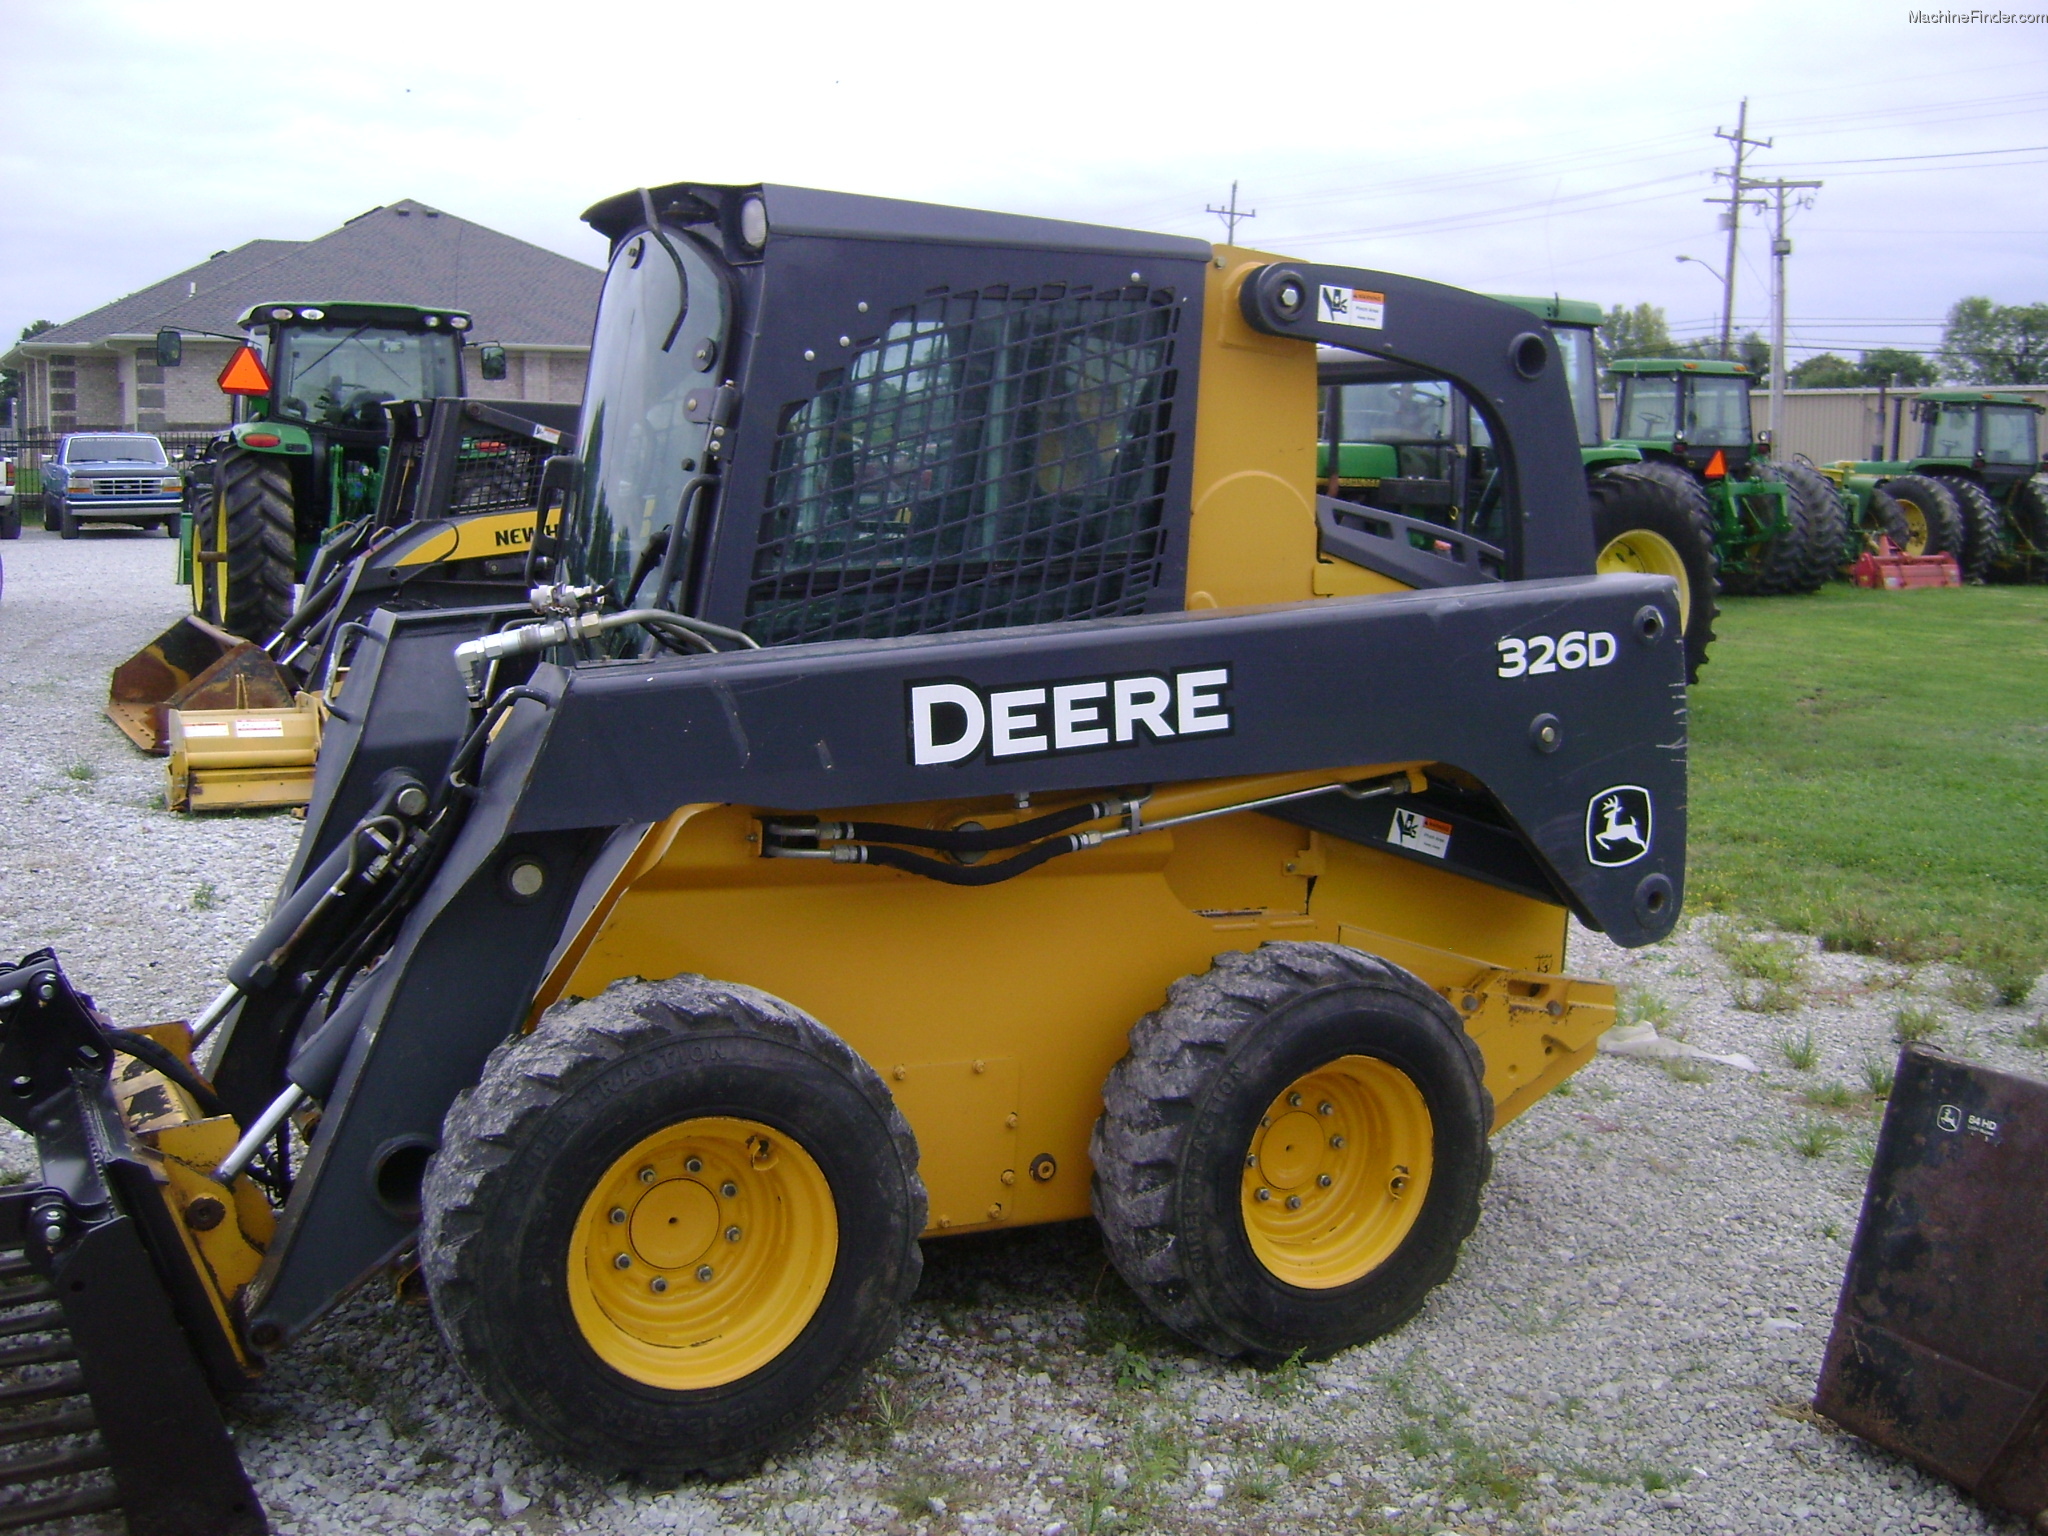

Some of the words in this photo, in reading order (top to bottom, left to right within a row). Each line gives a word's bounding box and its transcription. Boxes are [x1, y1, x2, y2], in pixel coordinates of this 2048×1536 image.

[1498, 631, 1616, 678] 326D
[911, 668, 1230, 766] DEERE
[1982, 1118, 1997, 1130] HD
